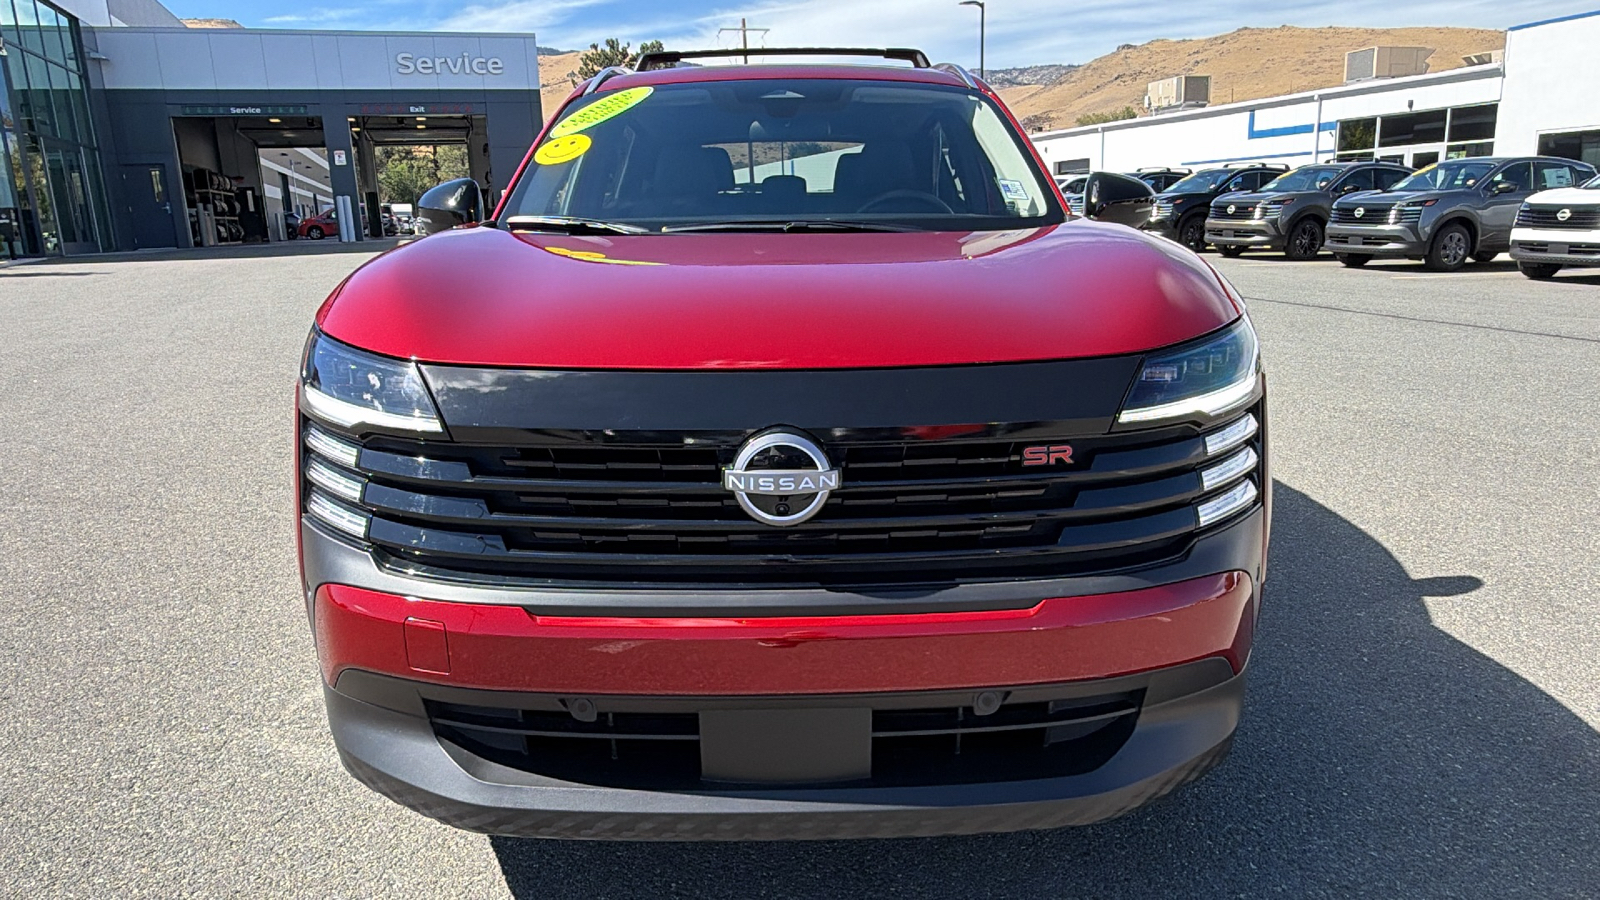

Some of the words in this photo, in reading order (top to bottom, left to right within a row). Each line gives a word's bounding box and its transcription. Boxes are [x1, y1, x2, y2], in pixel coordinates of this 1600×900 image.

[396, 52, 504, 74] Service
[230, 106, 261, 114] Service
[1023, 445, 1074, 466] SR
[728, 474, 836, 491] NISSAN
